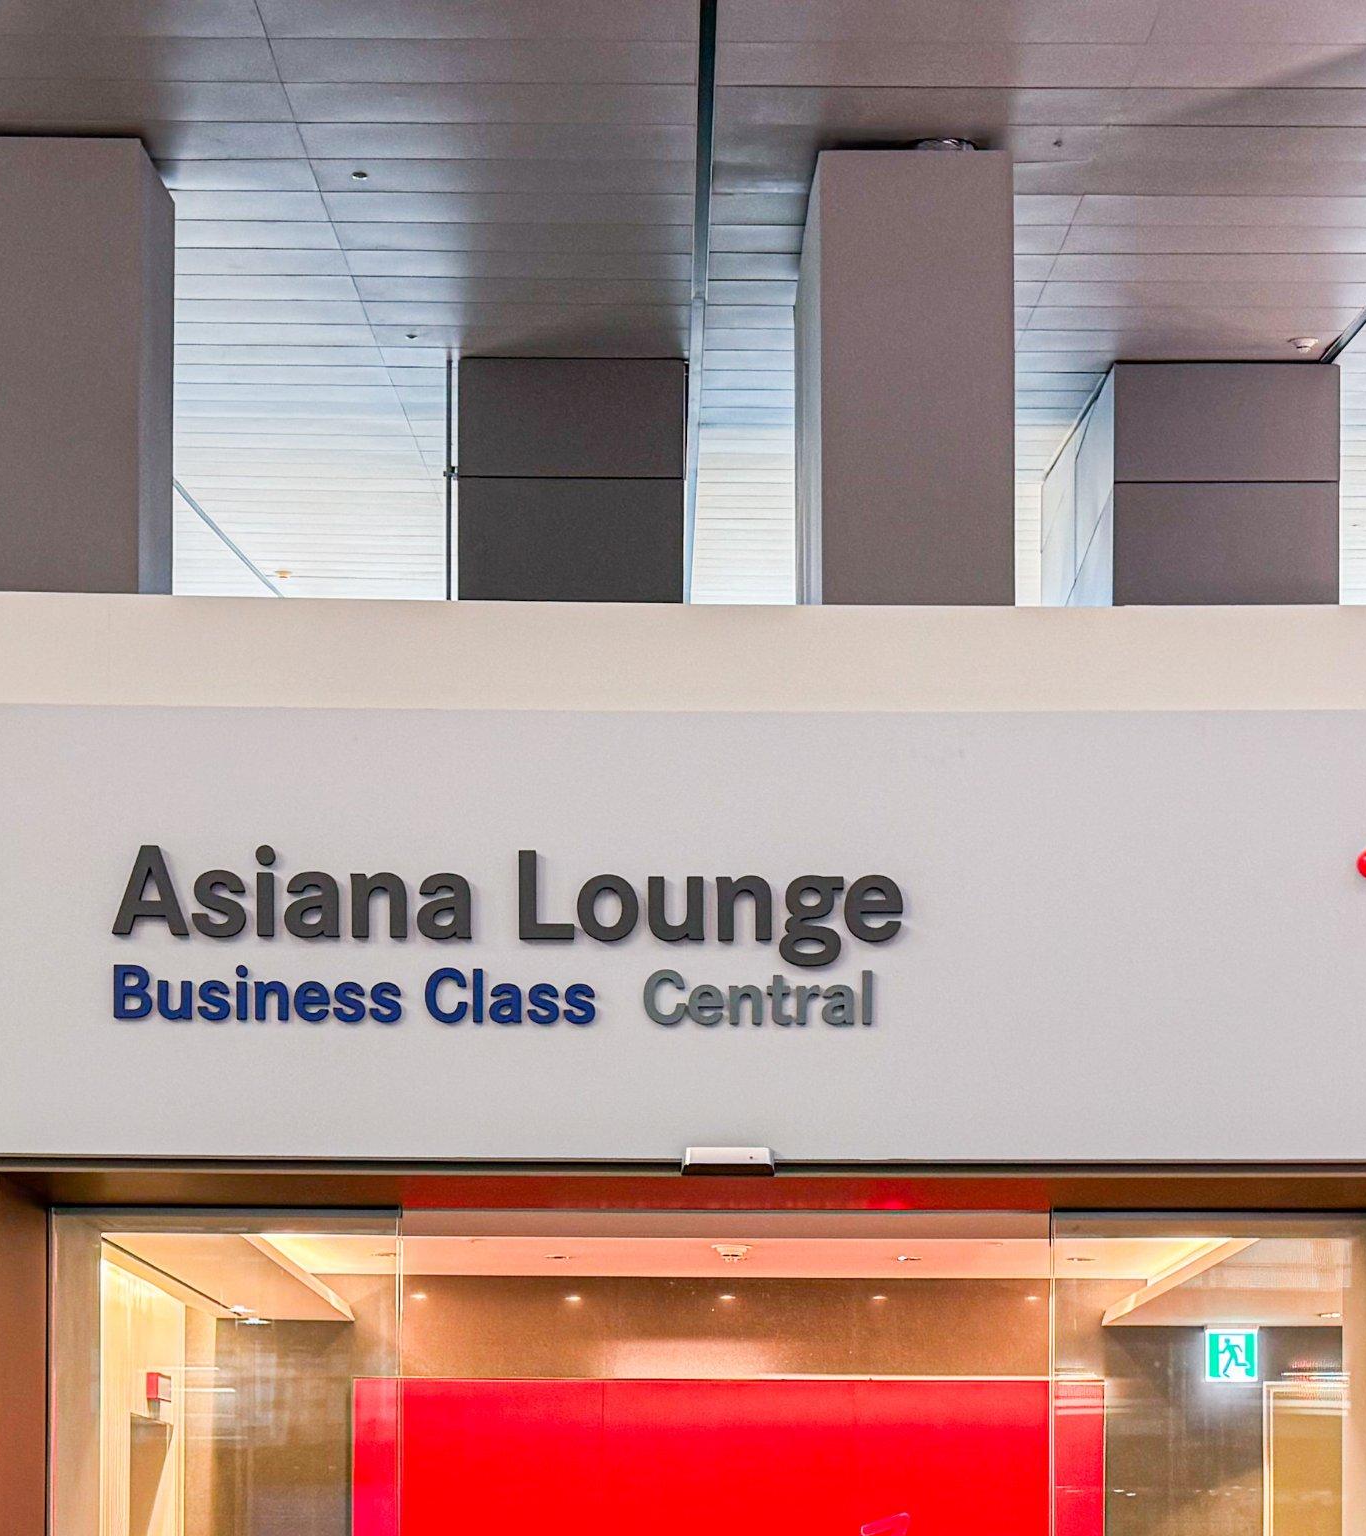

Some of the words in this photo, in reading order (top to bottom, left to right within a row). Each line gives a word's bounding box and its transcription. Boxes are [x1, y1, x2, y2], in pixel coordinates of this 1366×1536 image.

[111, 844, 473, 940] Asiana
[517, 849, 905, 966] Lounge
[113, 964, 403, 1025] Business
[424, 965, 597, 1026] Class
[643, 969, 875, 1028] Central
